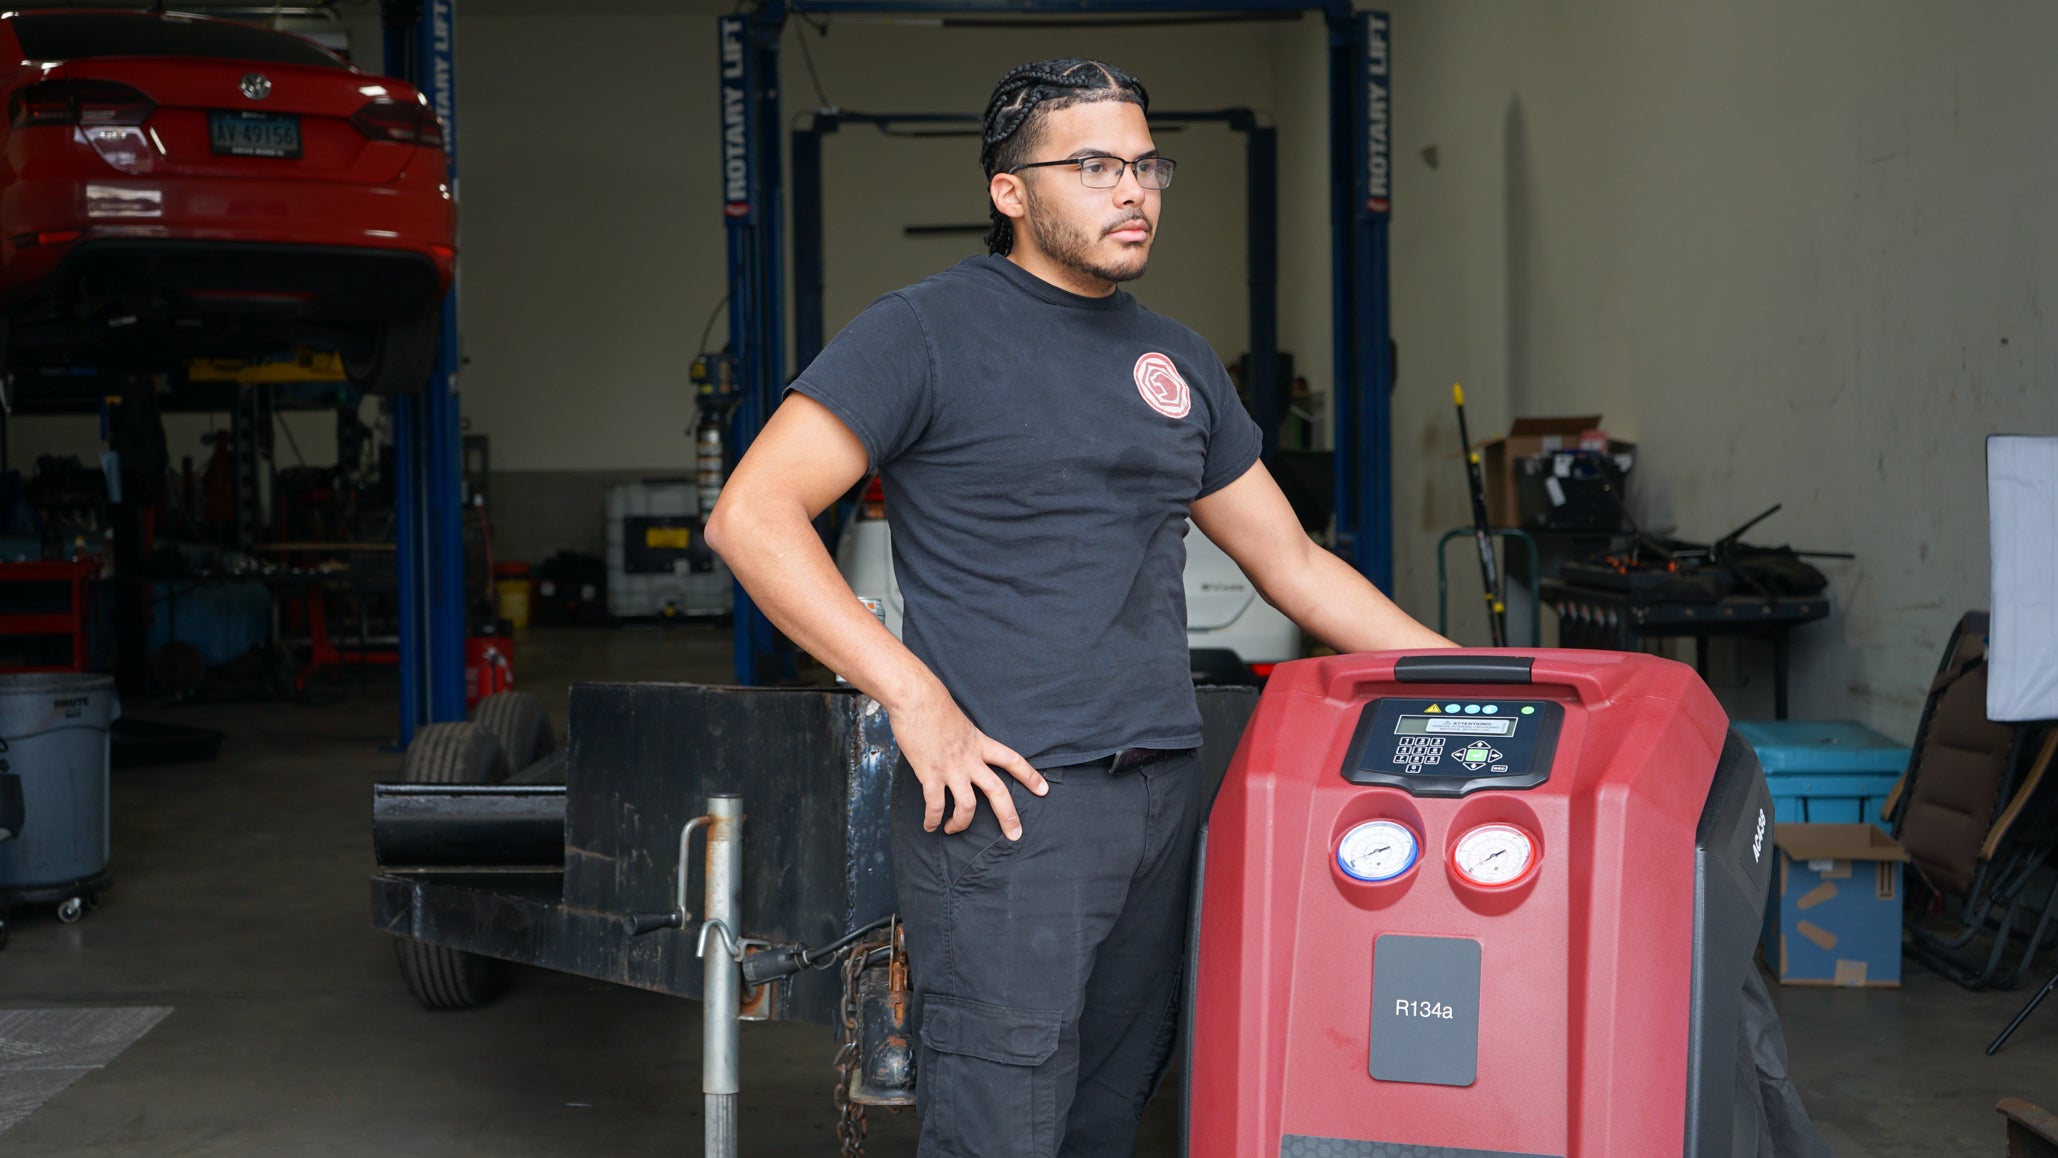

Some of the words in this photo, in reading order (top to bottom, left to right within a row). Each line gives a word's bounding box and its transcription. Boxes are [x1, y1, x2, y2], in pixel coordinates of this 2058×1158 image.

[433, 0, 449, 52] LIFT
[722, 19, 744, 79] LIFT
[1368, 15, 1388, 76] LIFT
[723, 87, 747, 200] ROTARY
[1368, 83, 1389, 197] ROTARY
[1395, 999, 1453, 1019] R134a
